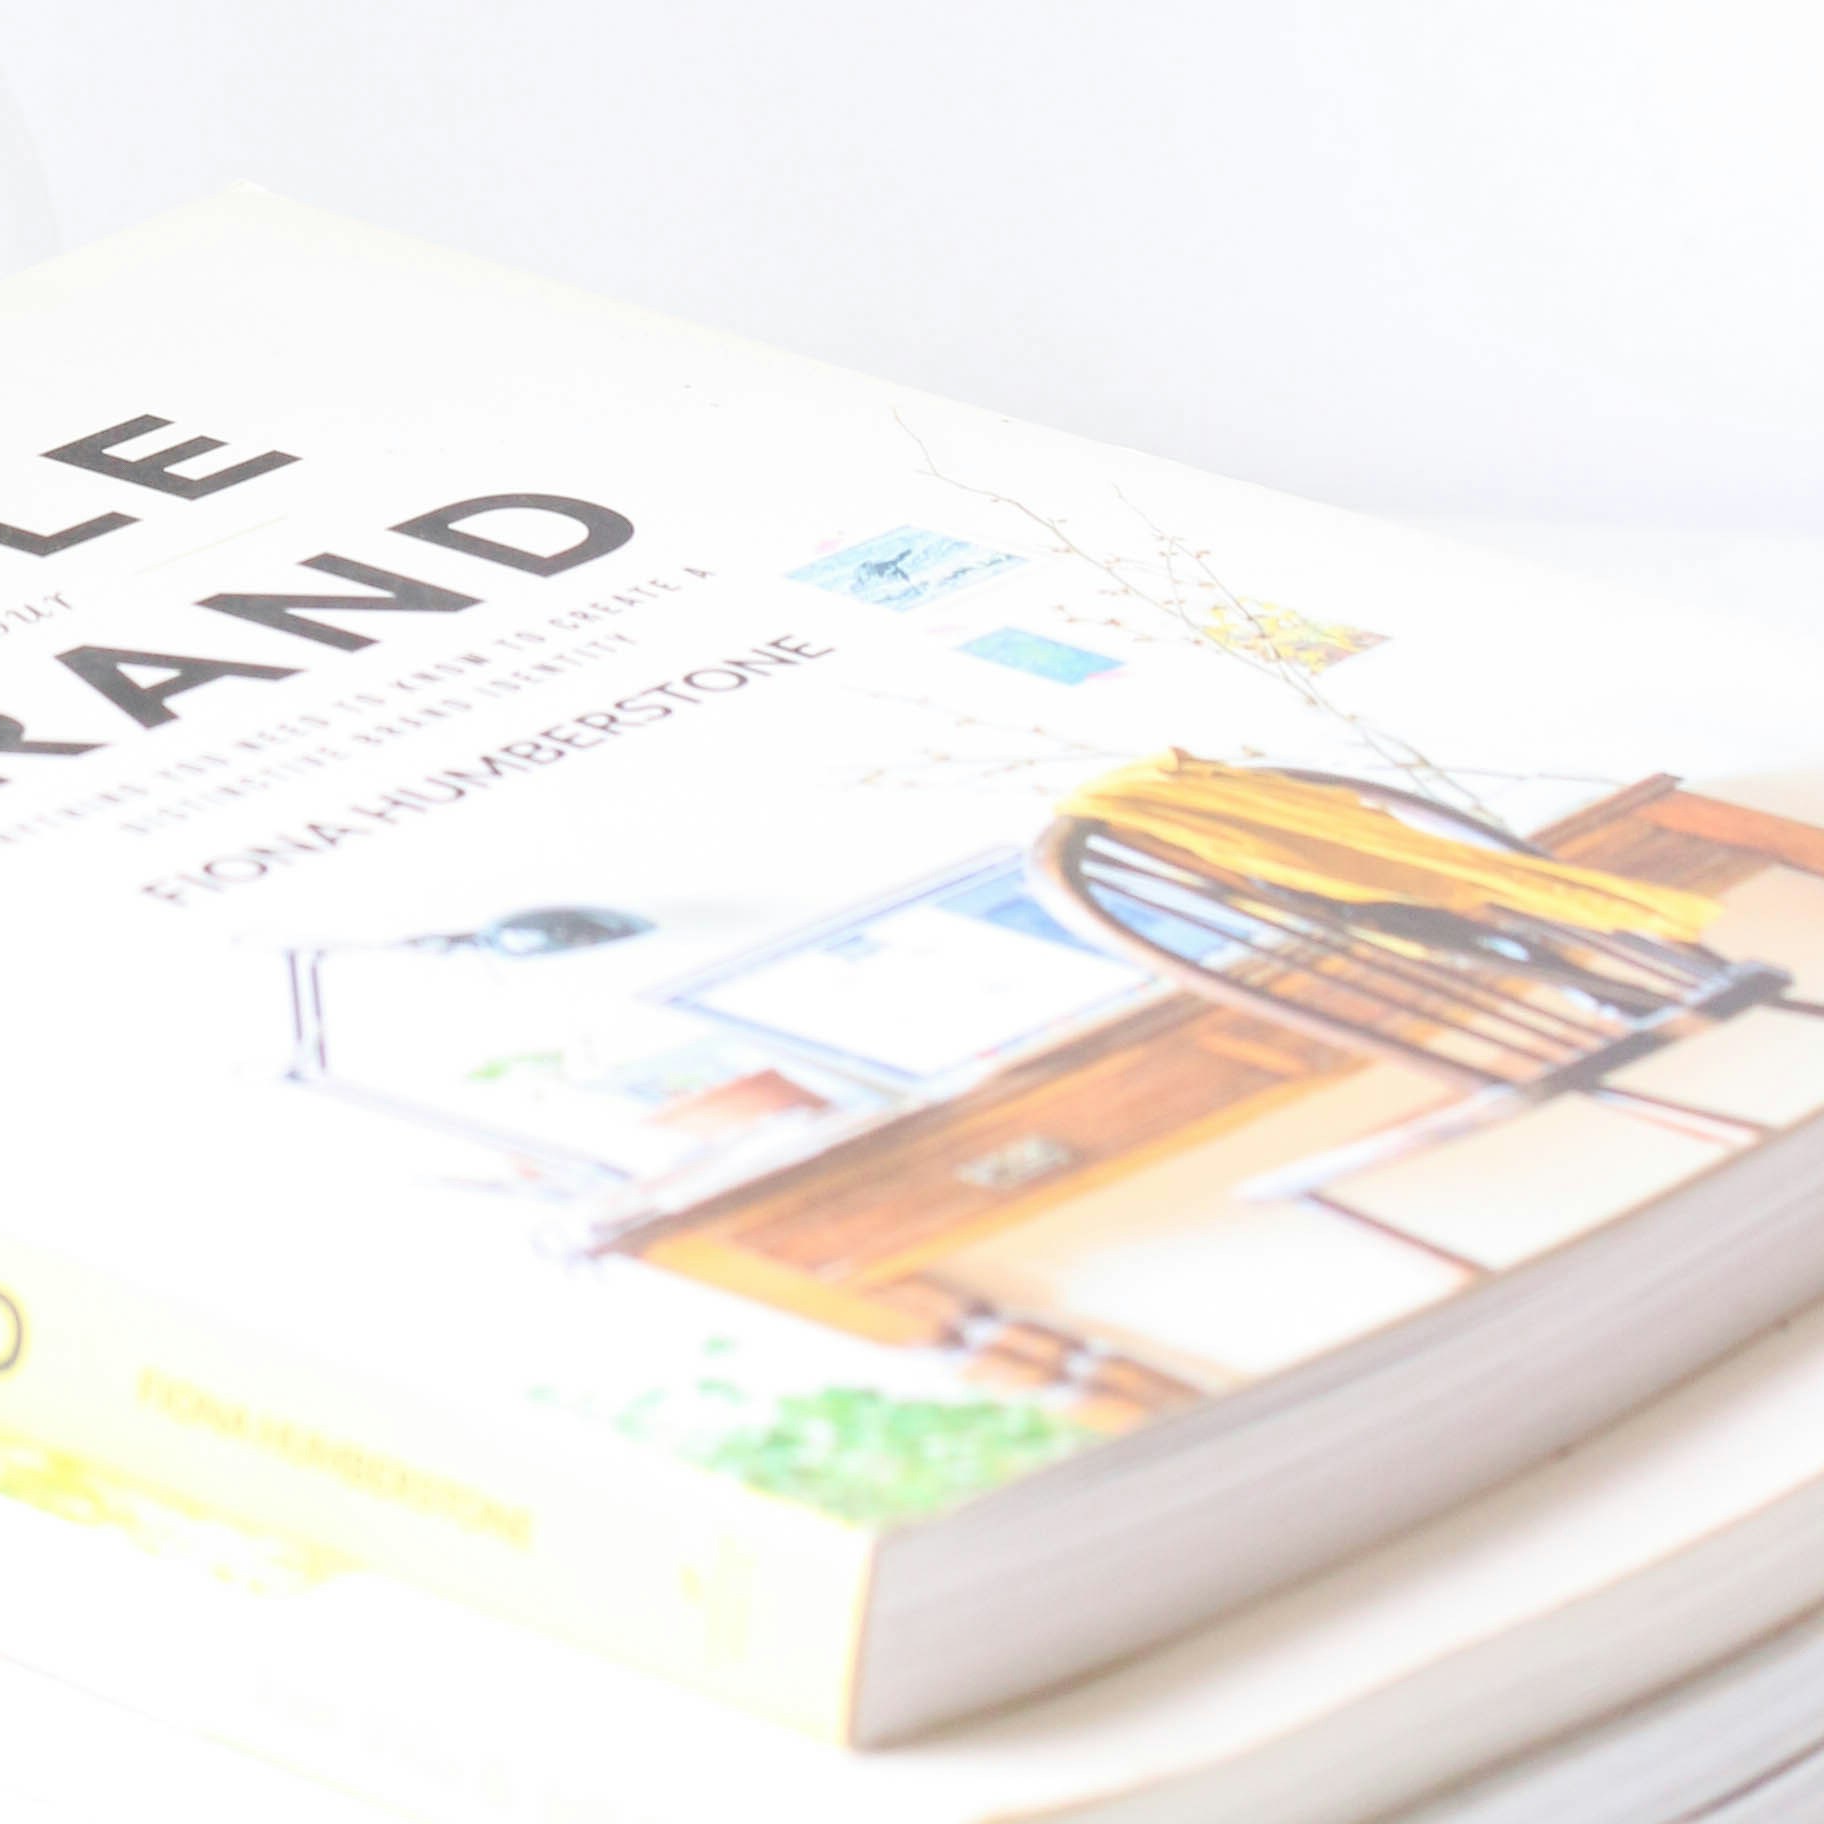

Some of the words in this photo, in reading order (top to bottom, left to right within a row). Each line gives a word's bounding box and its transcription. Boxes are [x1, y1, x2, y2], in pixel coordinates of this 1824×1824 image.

[233, 713, 331, 755] NEED
[332, 691, 385, 716] TO
[387, 651, 491, 694] KNOW
[492, 629, 547, 651] TO
[547, 575, 684, 632] CREATE
[682, 564, 721, 582] A
[351, 696, 473, 747] BRAND
[473, 631, 639, 698] IDENTITY
[138, 821, 374, 909] FIONA
[348, 632, 838, 826] HUMBERSTONE
